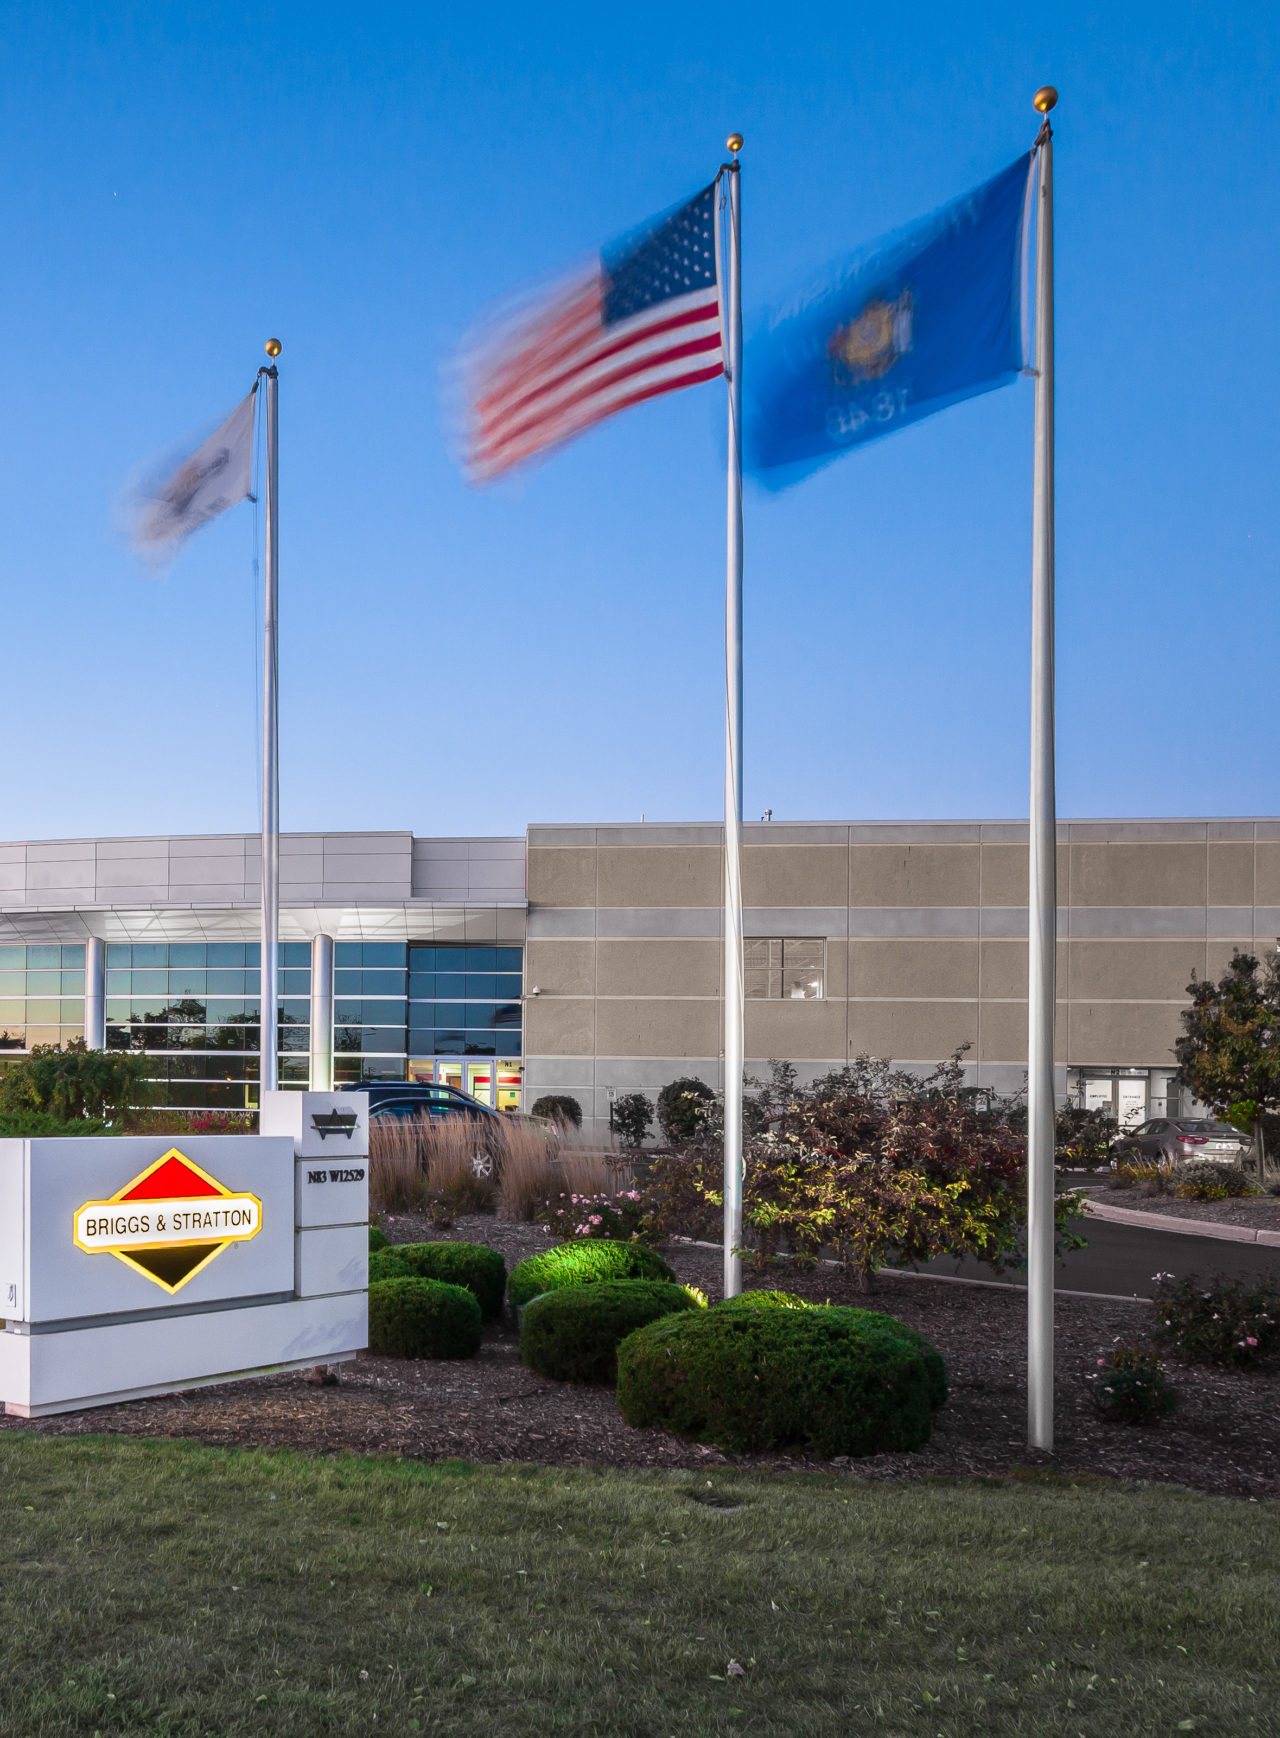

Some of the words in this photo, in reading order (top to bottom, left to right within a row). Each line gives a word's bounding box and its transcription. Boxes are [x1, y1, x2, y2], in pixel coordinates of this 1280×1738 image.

[308, 1170, 327, 1184] N83
[329, 1169, 365, 1182] W12529
[86, 1215, 150, 1237] BRIGGS
[156, 1214, 166, 1232] &
[173, 1208, 252, 1230] STRATTON
